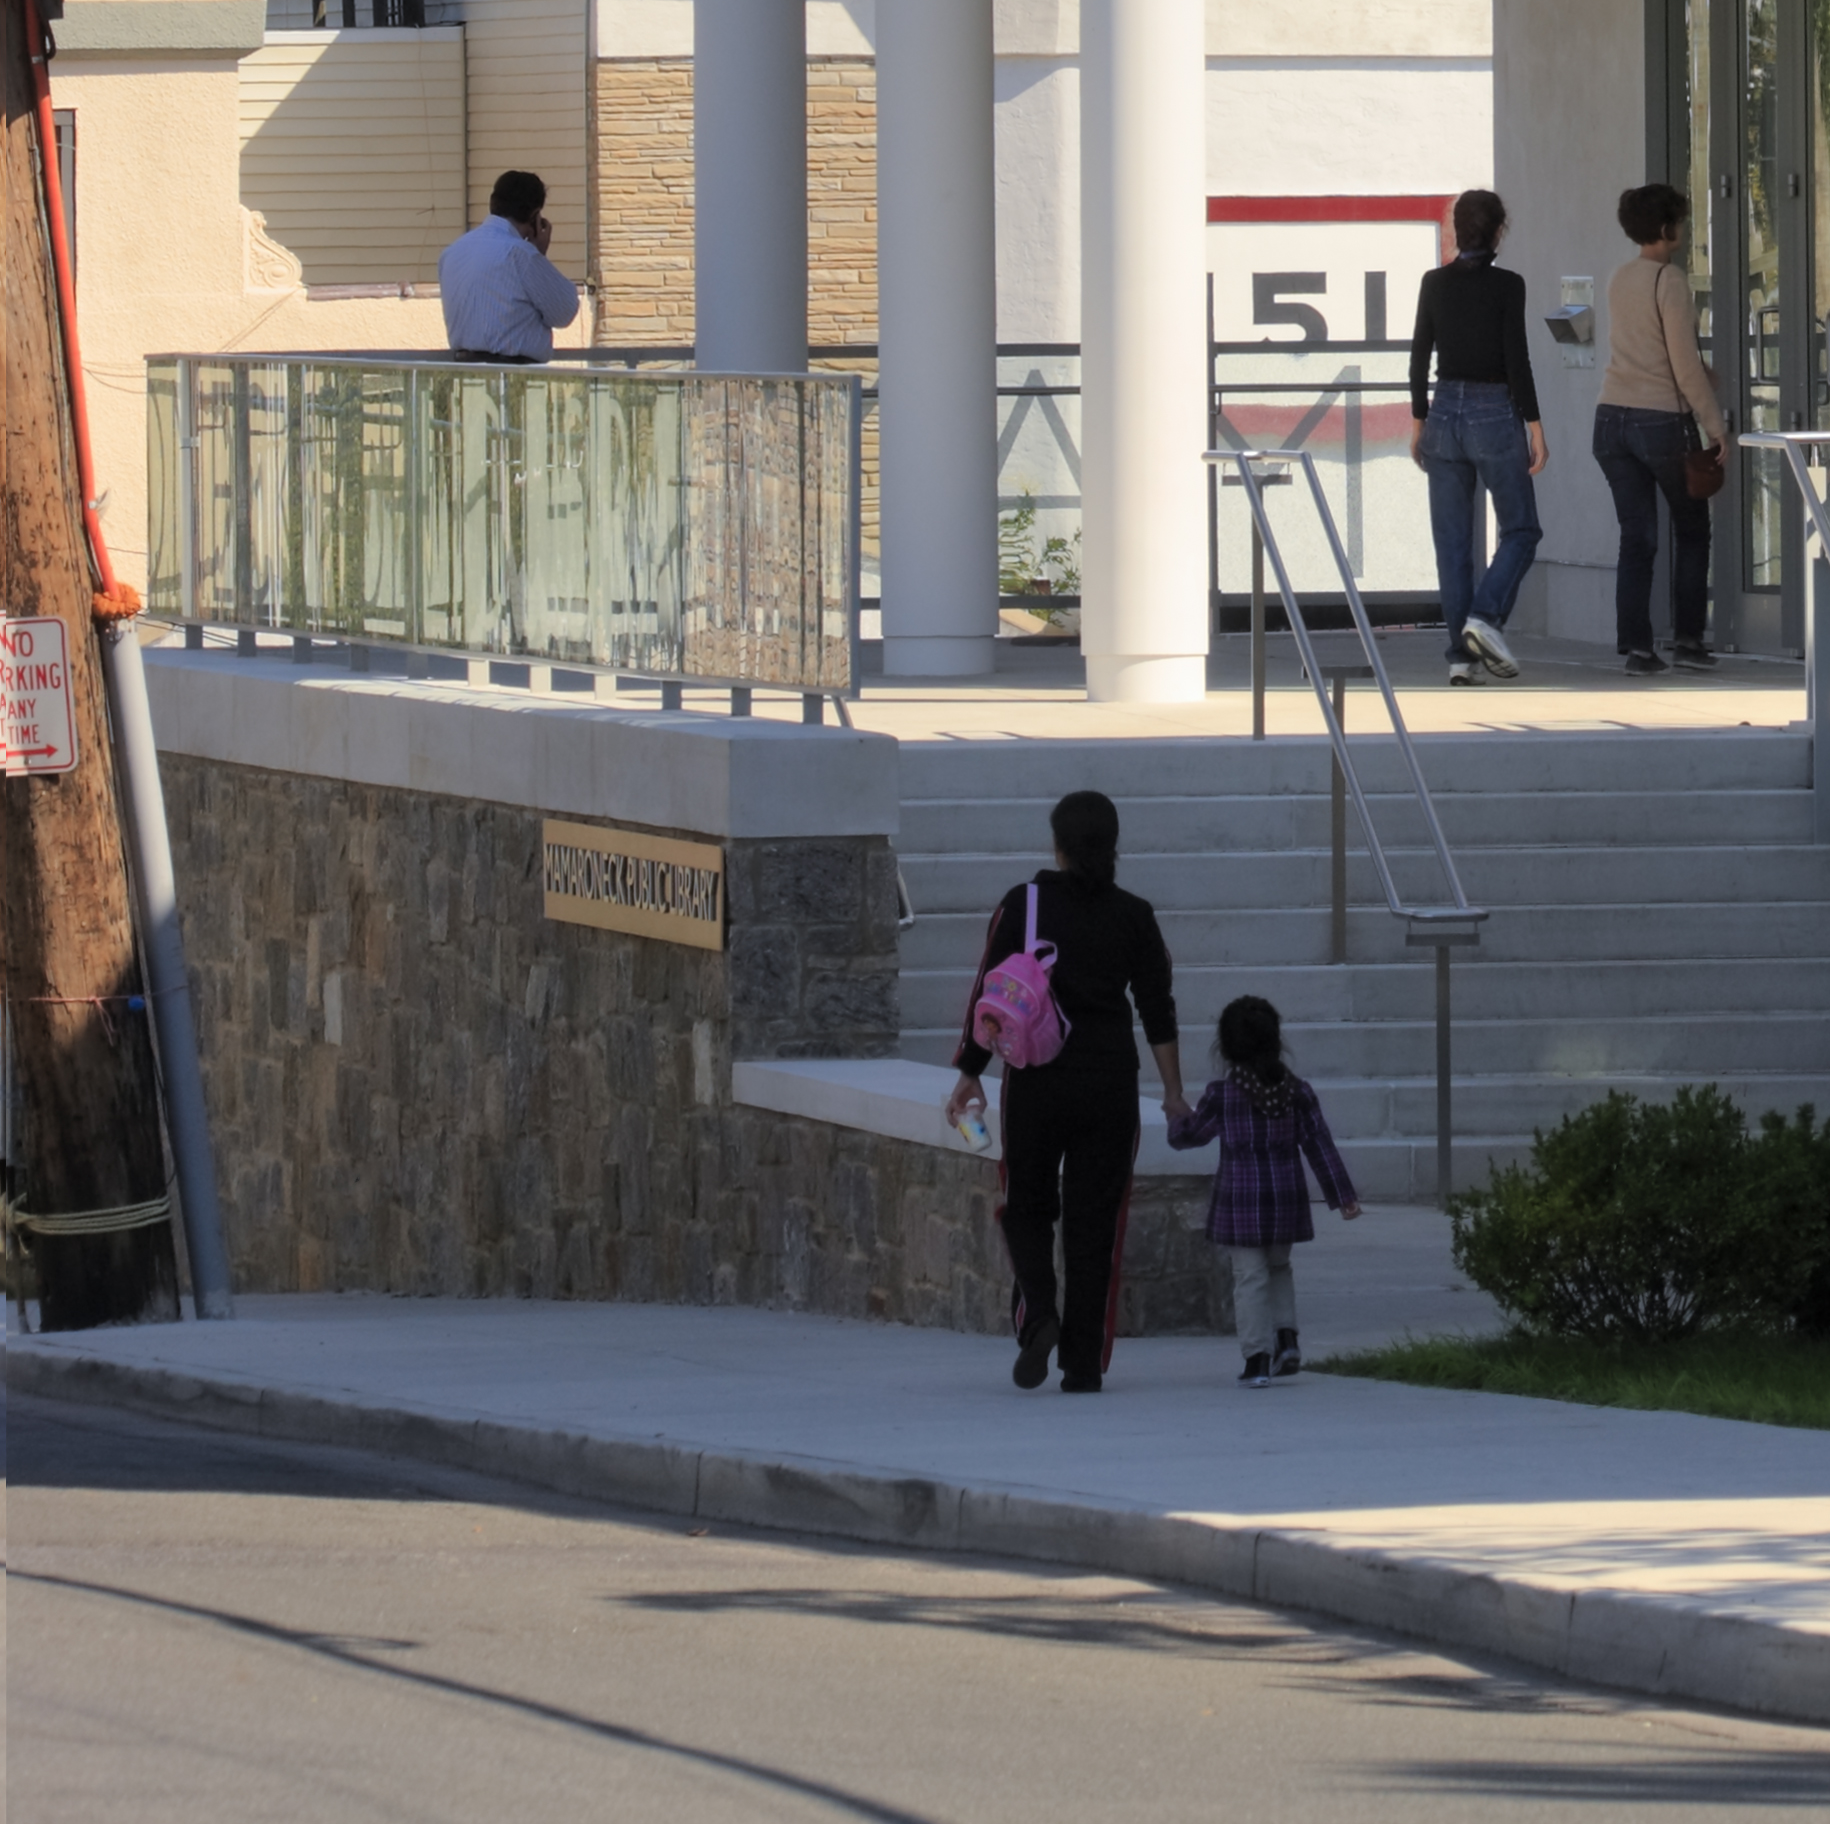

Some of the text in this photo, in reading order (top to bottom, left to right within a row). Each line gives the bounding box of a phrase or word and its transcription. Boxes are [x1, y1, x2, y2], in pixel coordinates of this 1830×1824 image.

[2, 662, 61, 691] RKING
[7, 698, 37, 720] ANY
[7, 723, 41, 745] TIME
[544, 842, 718, 922] MAMARONECK PUBLIC LIBRARY
